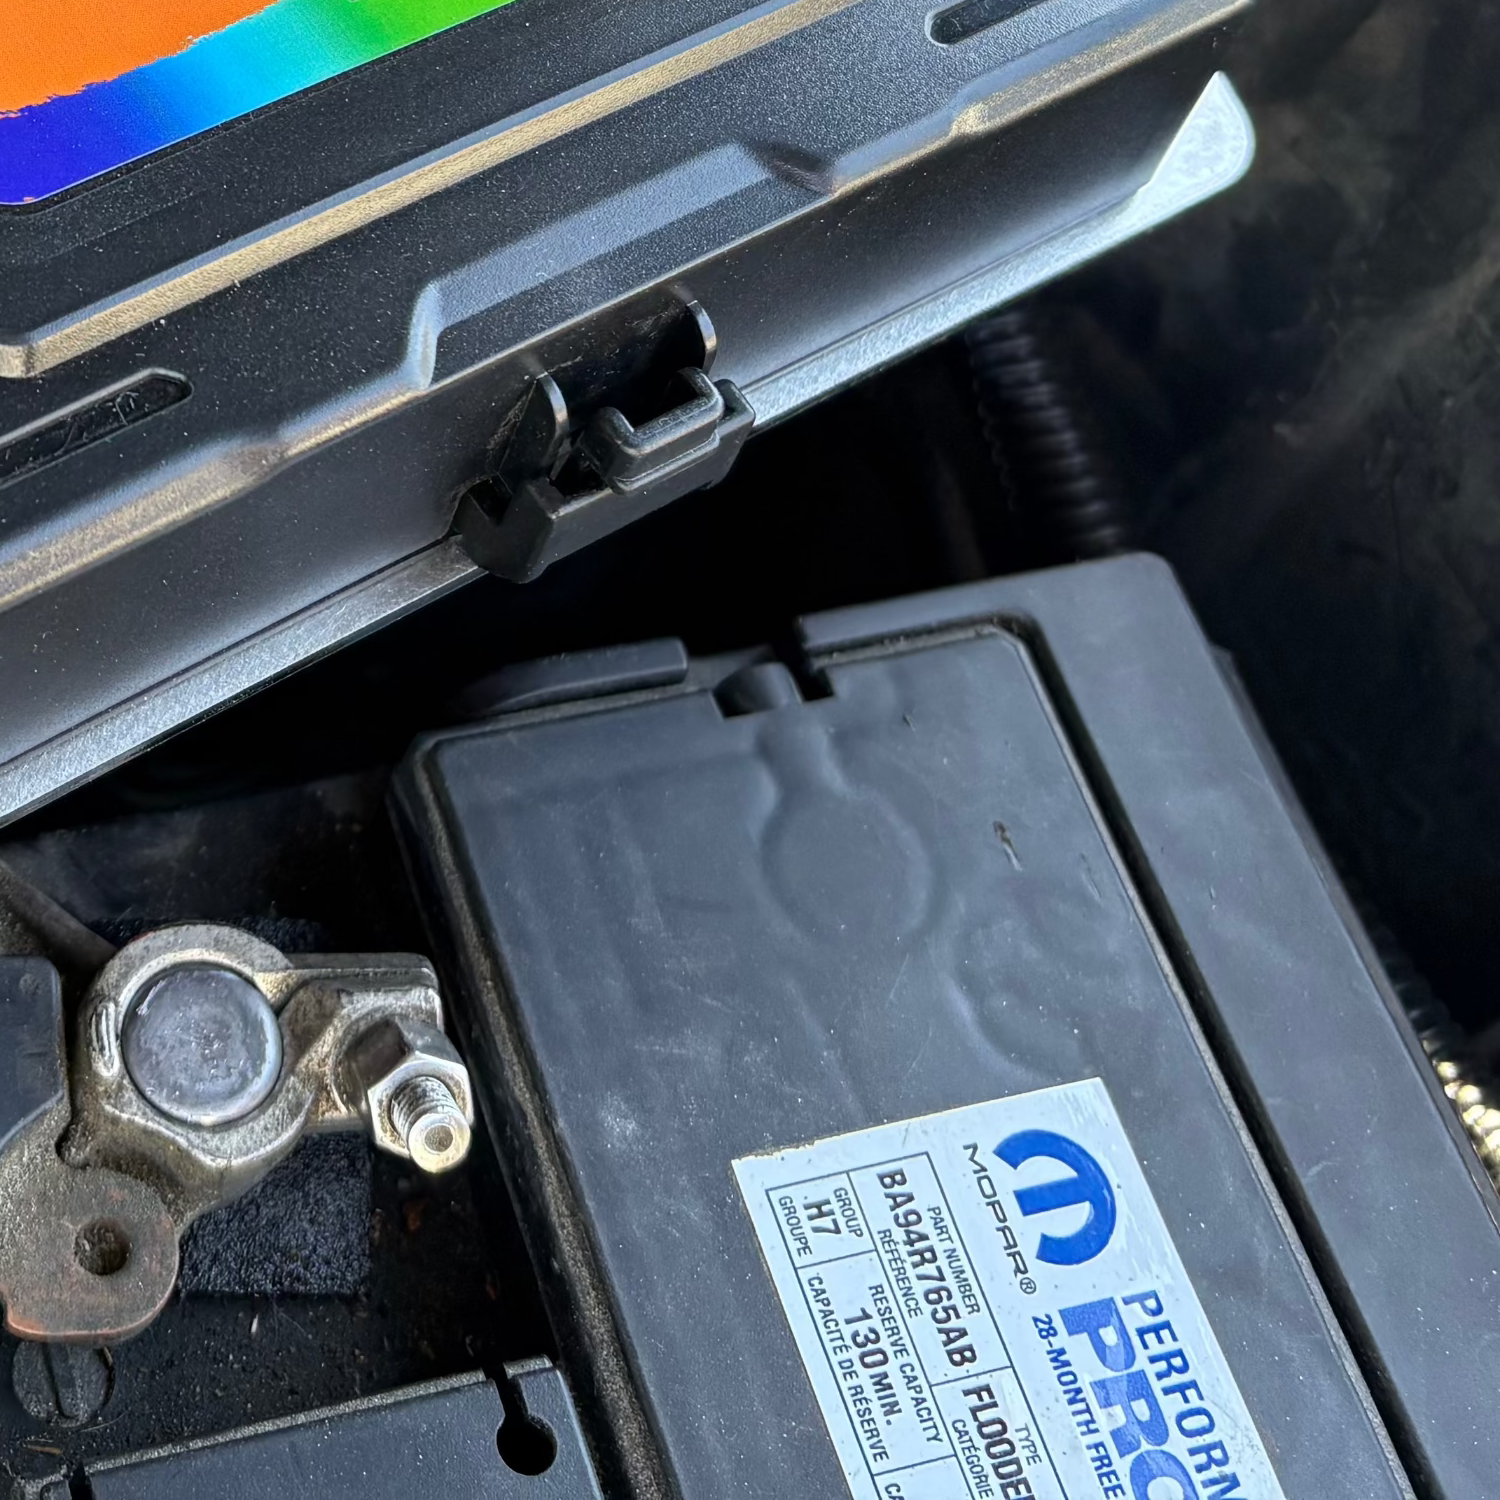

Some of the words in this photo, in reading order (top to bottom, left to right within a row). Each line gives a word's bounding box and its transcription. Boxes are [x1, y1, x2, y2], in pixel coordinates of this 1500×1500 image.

[778, 1195, 813, 1258] GROUPE
[802, 1197, 842, 1236] H7
[833, 1186, 864, 1239] GROUP
[876, 1167, 978, 1368] BA94R765AB
[876, 1228, 924, 1319] RÉFÉRENCE
[927, 1205, 955, 1245] PART
[942, 1246, 981, 1316] NUMBER
[807, 1275, 852, 1356] CAPACITÉ
[837, 1359, 859, 1382] DE
[844, 1306, 889, 1369] 130
[869, 1371, 903, 1426] MIN.
[868, 1283, 911, 1360] RESERVE
[899, 1362, 944, 1443] CAPACITY
[847, 1384, 890, 1463] RÉSERVE
[1014, 1422, 1043, 1466] TYPE
[1032, 1312, 1101, 1437] 28-MONTH
[1086, 1440, 1127, 1500] FREE
[952, 1418, 995, 1500] CATÉGORIE
